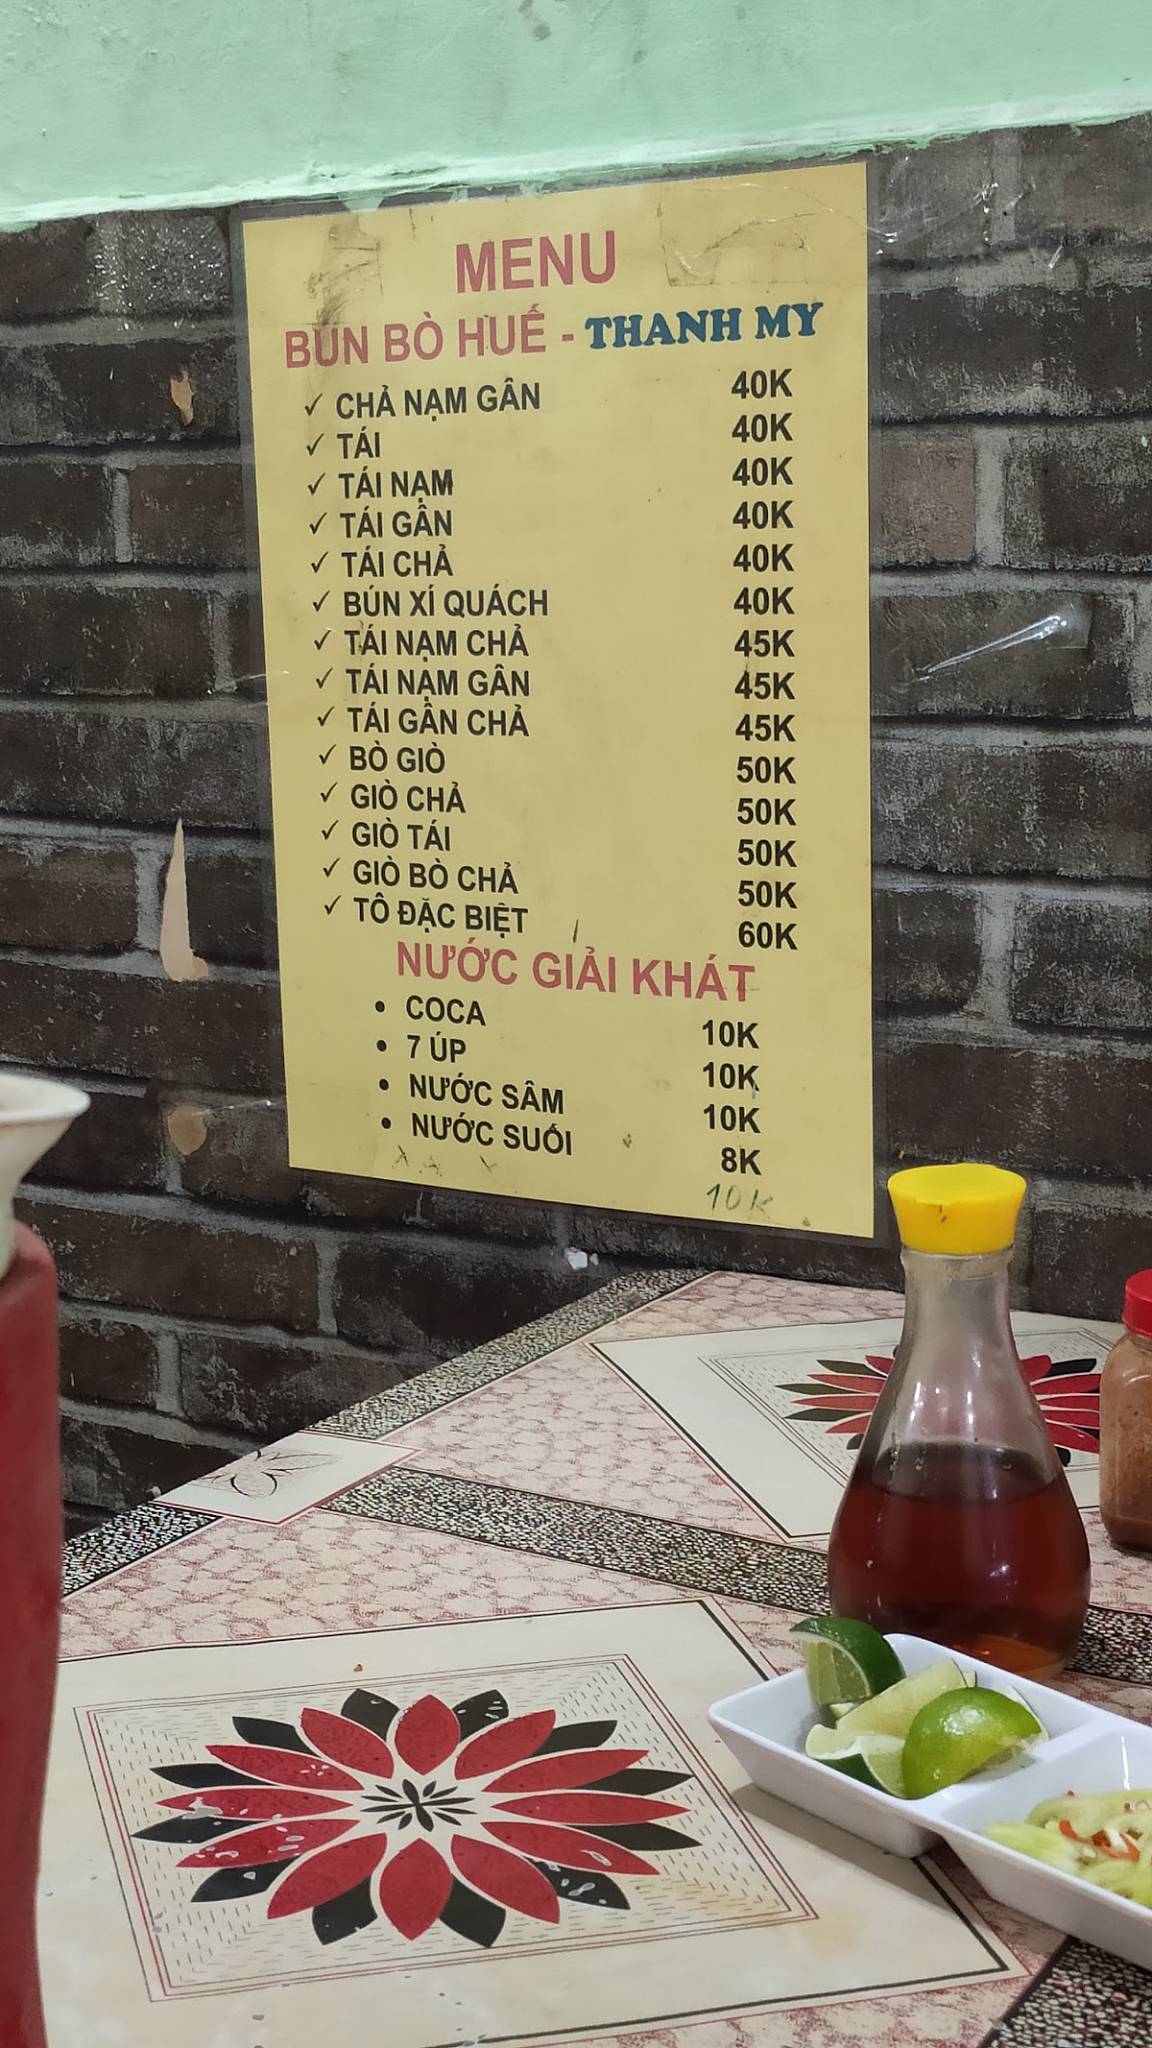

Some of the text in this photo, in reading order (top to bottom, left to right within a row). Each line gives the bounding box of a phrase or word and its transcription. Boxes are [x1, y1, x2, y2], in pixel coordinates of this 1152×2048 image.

[455, 230, 617, 294] MENU
[383, 311, 444, 362] BÒ
[458, 303, 546, 358] HUẾ
[561, 333, 574, 343] -
[584, 307, 743, 350] THANH
[754, 301, 824, 340] MY
[335, 377, 541, 422] CHẢ NẠM GÂN
[730, 368, 794, 400] 40K
[336, 426, 382, 460] TÁI
[730, 412, 794, 444] 40K
[338, 466, 454, 503] TÁI NẠM
[730, 456, 795, 488] 40K
[339, 504, 453, 538] TÁI GÂN
[731, 499, 795, 532] 40K
[341, 544, 454, 578] TÁI CHẢ
[732, 542, 796, 574] 40K
[343, 584, 549, 618] BÚN XÍ QUÁCH
[732, 585, 796, 616] 40K
[344, 624, 529, 662] TÁI NẠM CHẢ
[733, 628, 797, 658] 45K
[346, 663, 530, 701] TÁI NẠM GÂN
[733, 670, 797, 701] 45K
[347, 702, 530, 736] TÁI GÂN CHẢ
[734, 713, 798, 743] 45K
[349, 740, 446, 774] BÒ GIÒ
[735, 755, 798, 785] 50K
[350, 779, 466, 814] GIÒ CHẢ
[735, 797, 798, 827] 50K
[352, 817, 451, 851] GIÒ TÁI
[736, 838, 798, 868] 50K
[353, 856, 519, 894] GIÒ BÒ CHẢ
[736, 879, 798, 909] 50K
[353, 892, 528, 938] TÔ ĐẶC BIỆT
[737, 921, 798, 952] 60K
[396, 937, 756, 1002] NƯỚC GIẢI KHÁT
[405, 995, 487, 1026] COCA
[407, 1031, 468, 1064] 7 ÚP
[701, 1019, 760, 1049] 10K
[701, 1061, 760, 1091] 10K
[409, 1072, 565, 1114] NƯỚC SÂM
[411, 1112, 574, 1156] NƯỚC SUỐI
[703, 1104, 762, 1134] 10K
[720, 1147, 762, 1176] 8K
